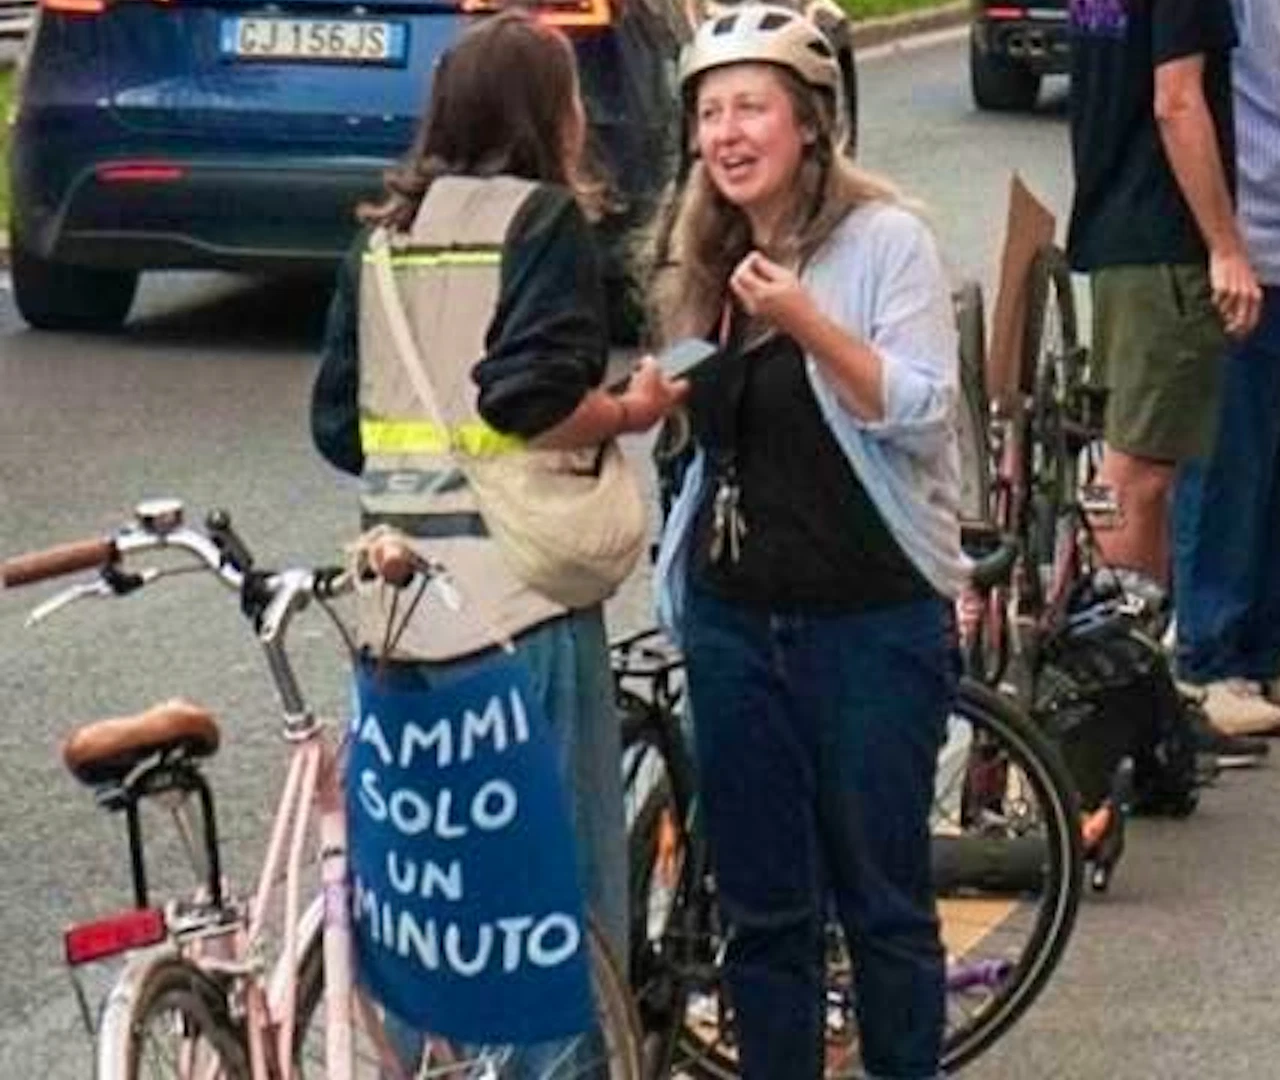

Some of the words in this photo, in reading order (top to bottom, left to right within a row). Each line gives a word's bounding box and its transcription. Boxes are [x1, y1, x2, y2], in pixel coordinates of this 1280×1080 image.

[353, 686, 529, 768] AMMI
[358, 769, 518, 838] SOLO
[386, 851, 463, 900] UN
[354, 875, 580, 977] MINUTO
